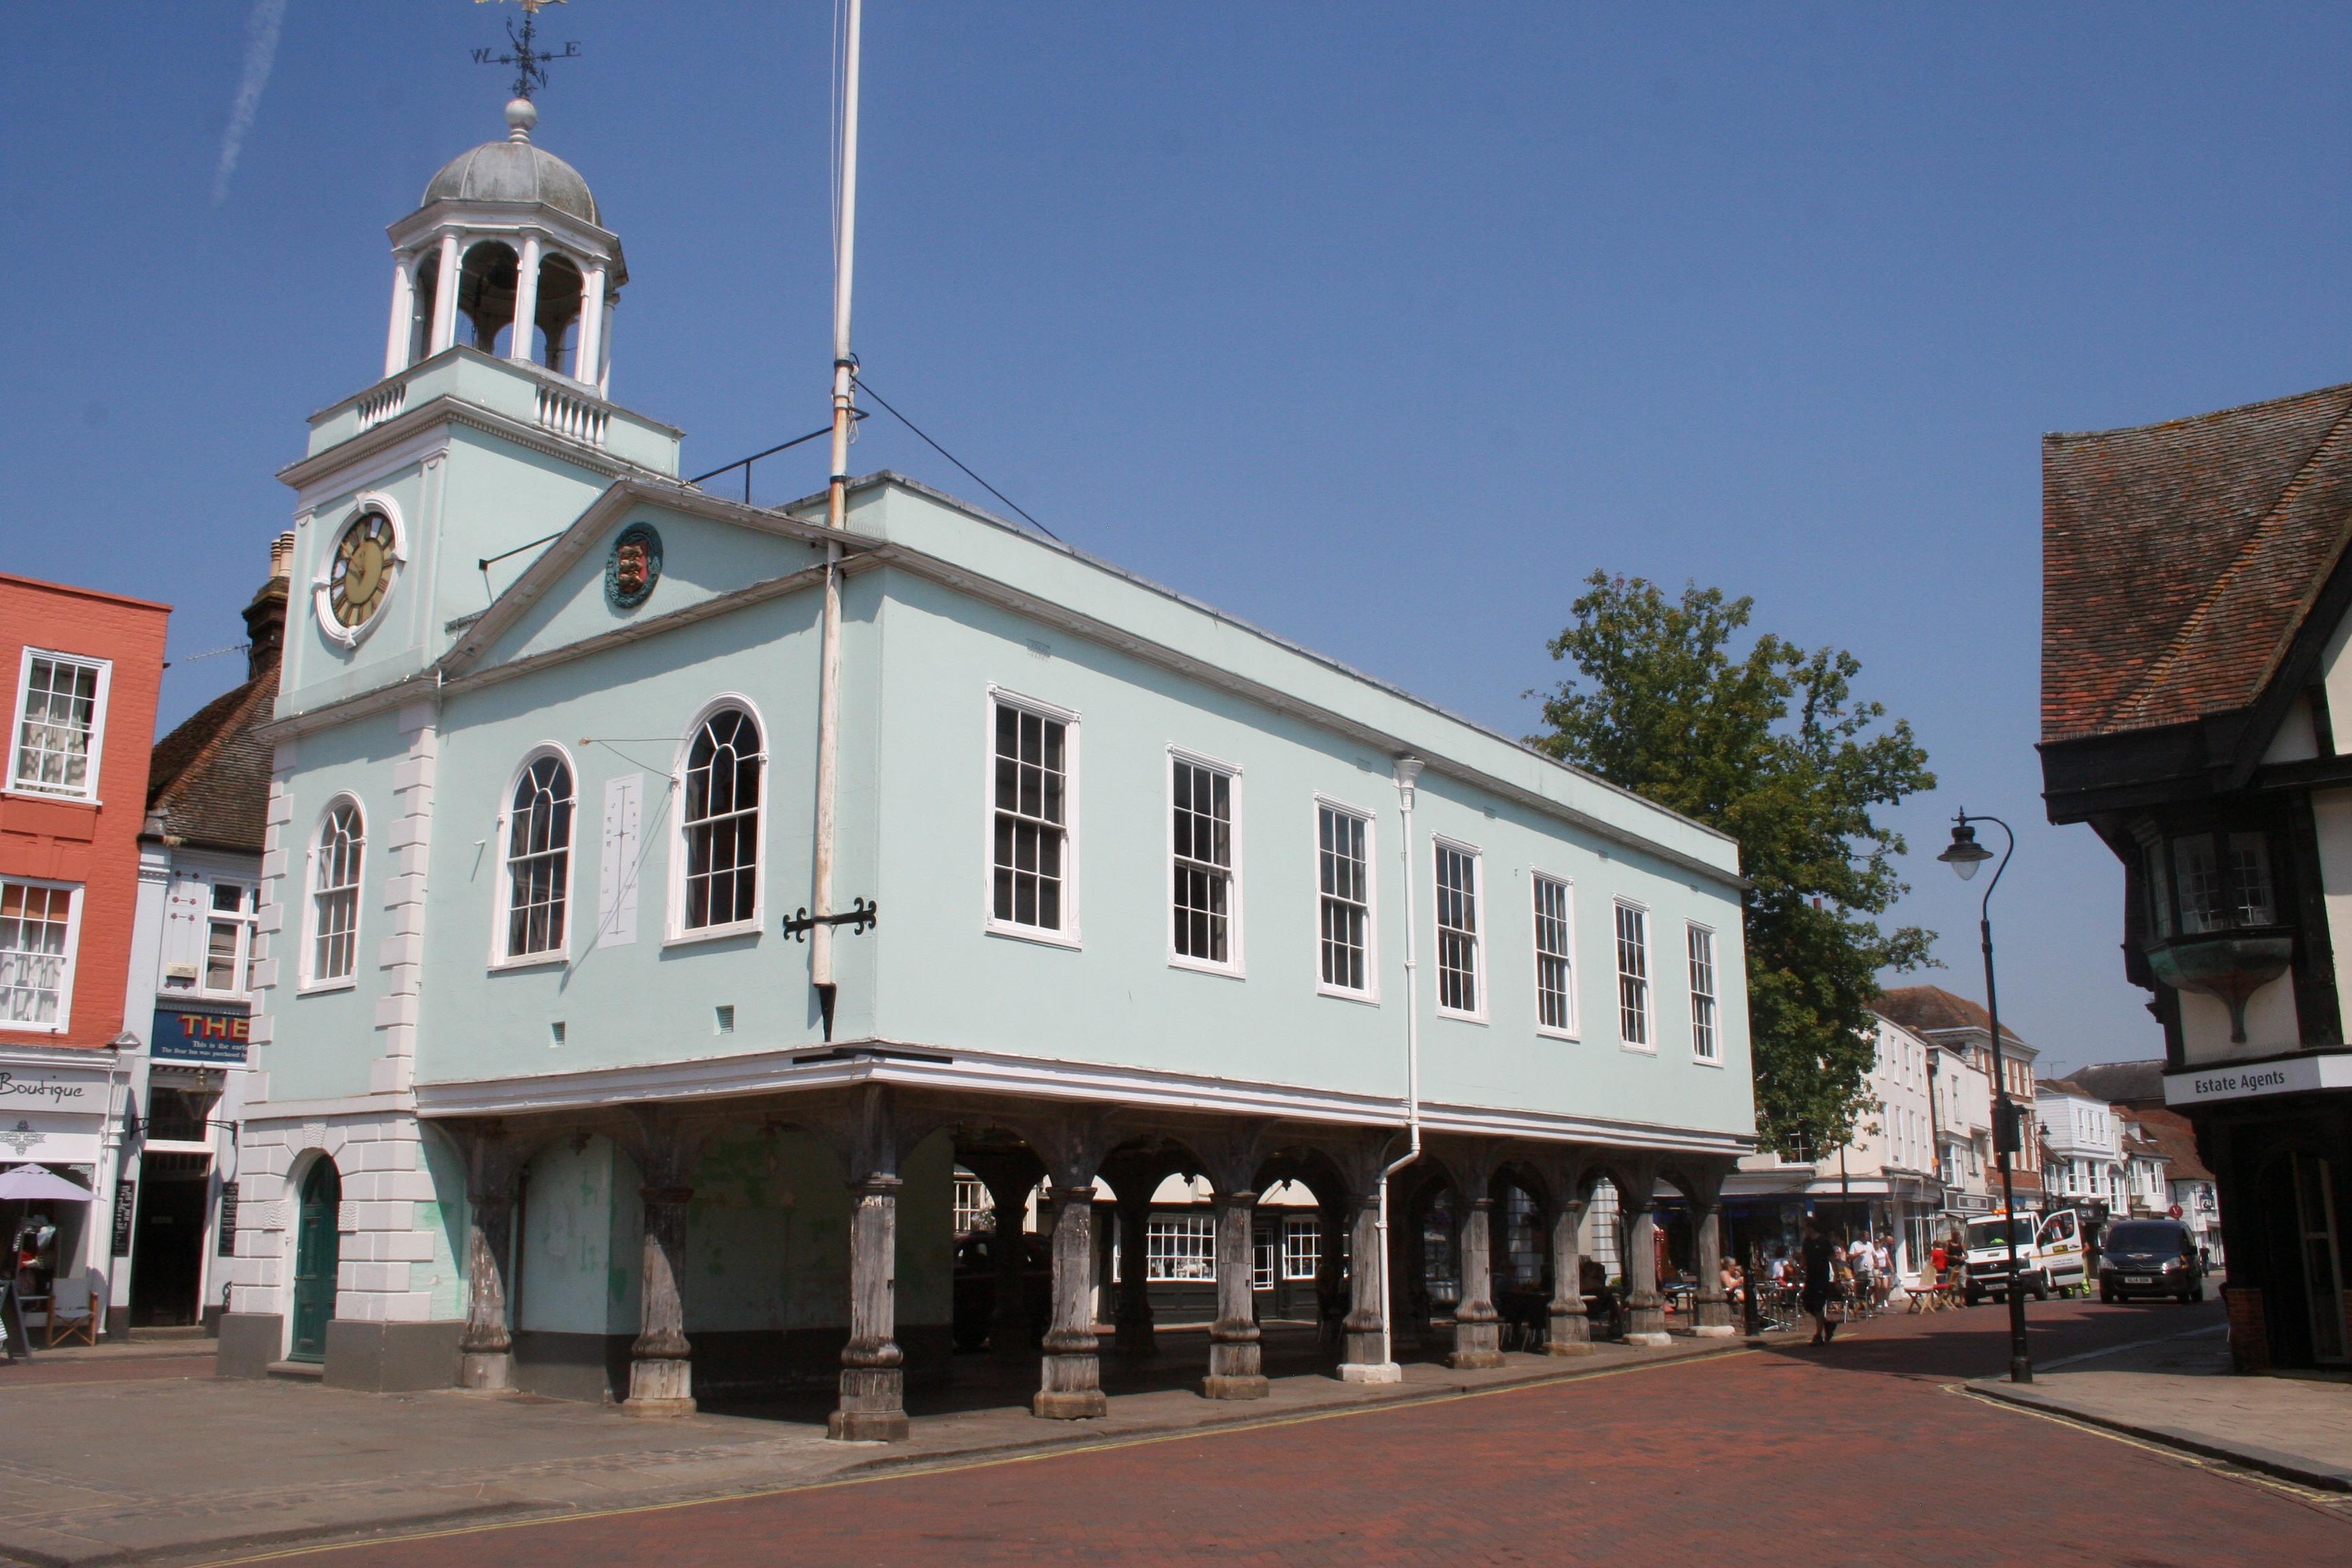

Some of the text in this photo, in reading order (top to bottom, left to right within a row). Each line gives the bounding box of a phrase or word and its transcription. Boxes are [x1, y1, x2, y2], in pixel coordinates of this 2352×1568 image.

[470, 47, 491, 65] W
[565, 41, 581, 56] E
[178, 1014, 249, 1041] THE
[193, 1040, 207, 1049] This
[0, 1072, 85, 1104] Boutique
[2195, 1071, 2285, 1094] Estate Agents
